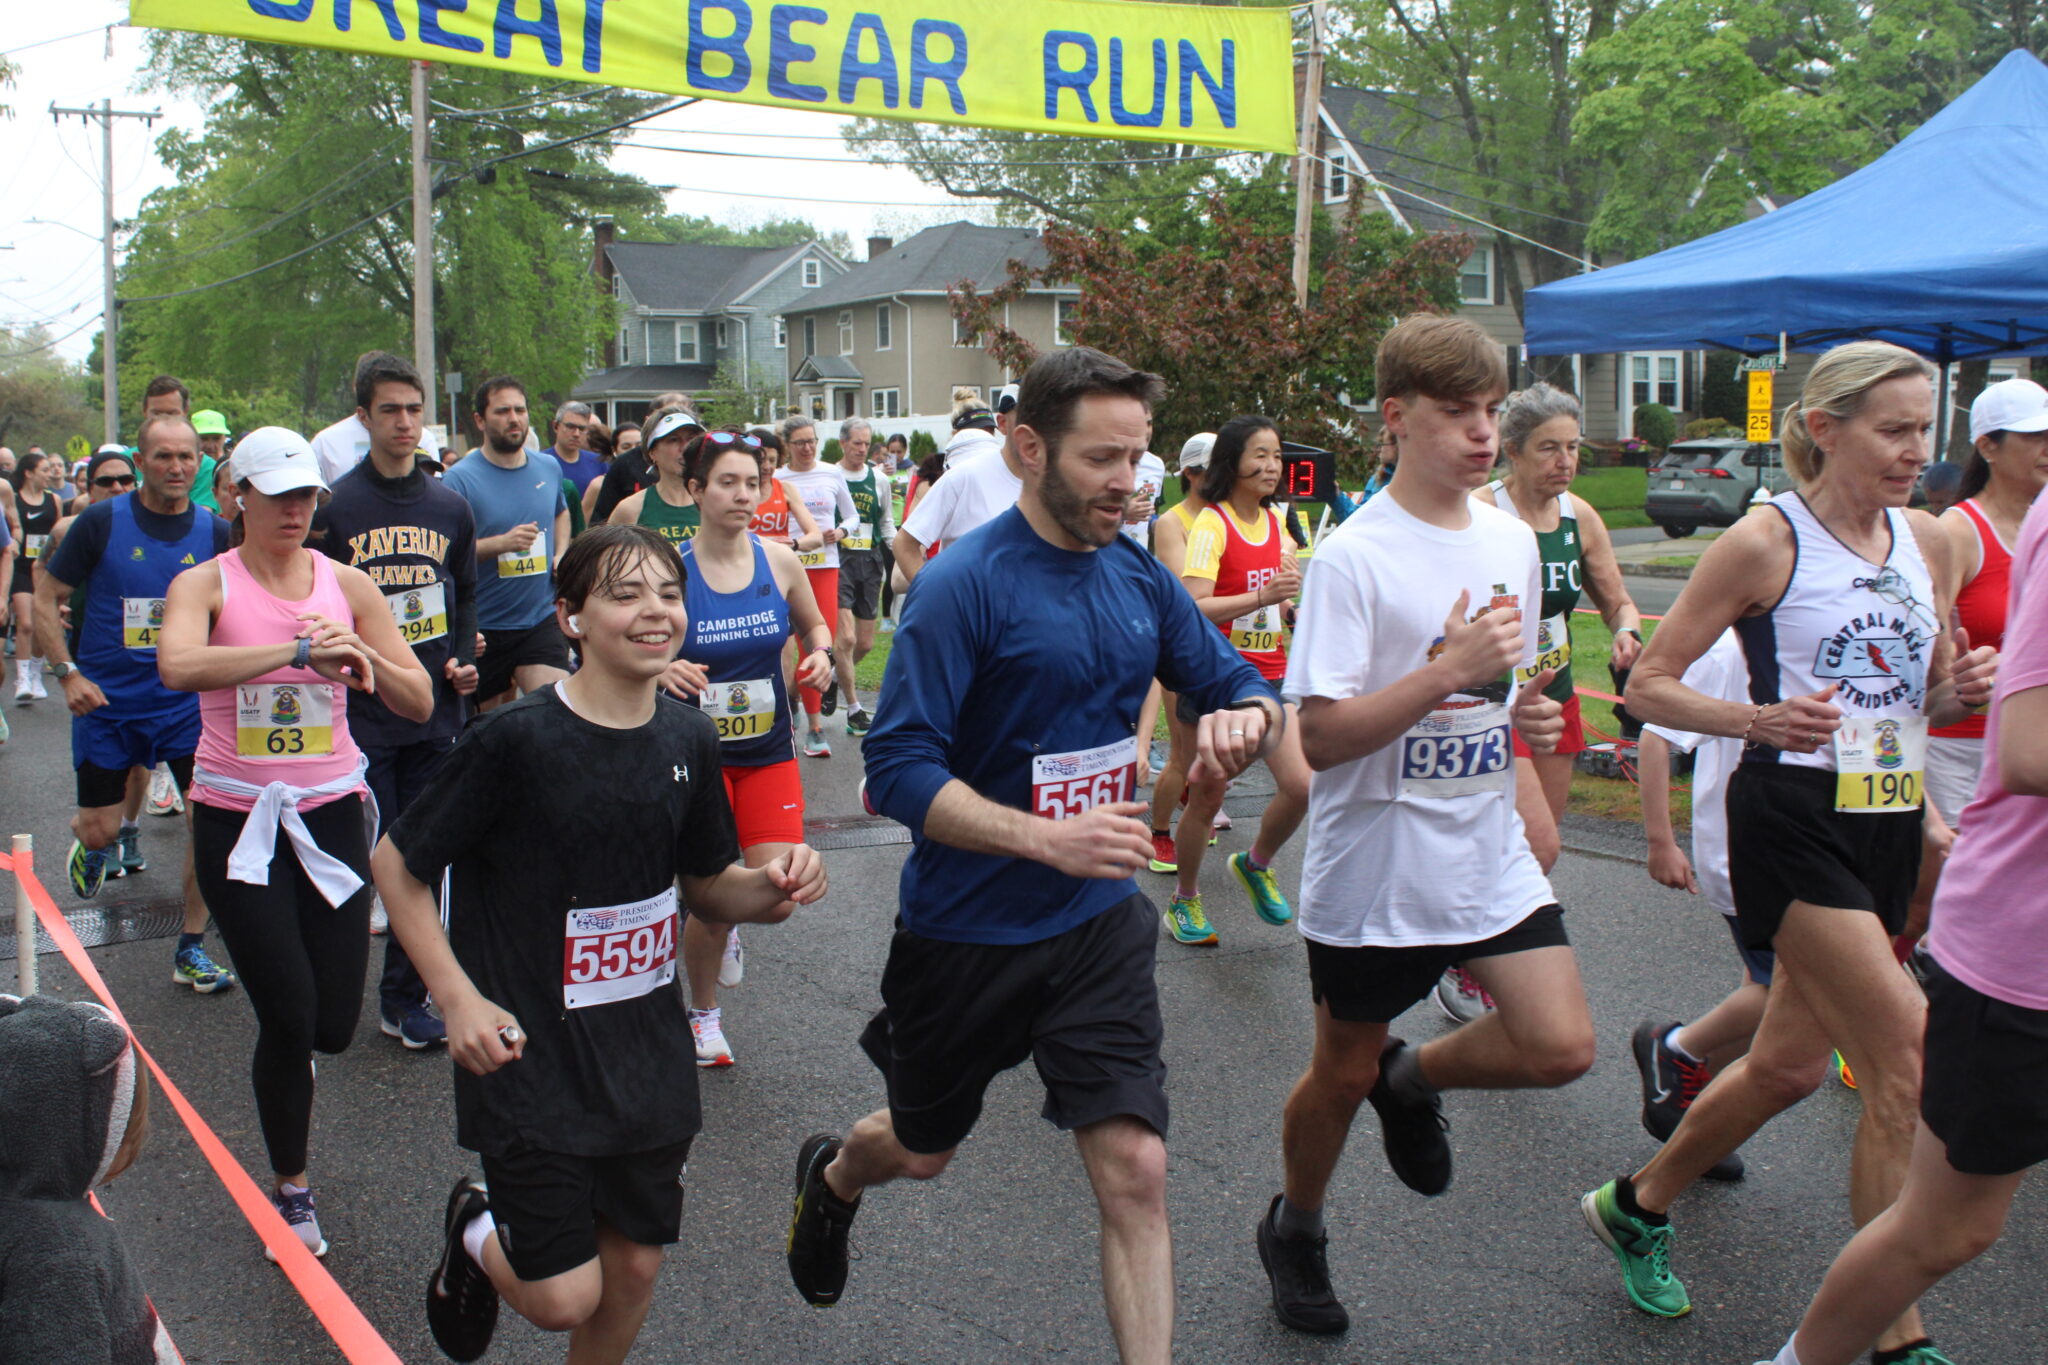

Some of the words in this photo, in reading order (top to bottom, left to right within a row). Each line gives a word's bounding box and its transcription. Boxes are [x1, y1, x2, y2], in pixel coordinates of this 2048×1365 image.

[248, 0, 602, 73] EAT
[686, 0, 967, 115] BEAR
[1043, 30, 1236, 128] RUN
[1750, 415, 1769, 430] 25
[1289, 461, 1314, 495] 13
[749, 512, 788, 531] CSU
[349, 526, 450, 566] XAVERIAN
[851, 538, 863, 548] 75
[369, 564, 437, 585] HAWKS
[515, 557, 535, 573] 44
[1540, 560, 1582, 591] FC
[697, 609, 776, 633] CAMBRIDGE
[696, 629, 750, 645] RUNNING
[753, 623, 780, 637] CLUB
[1240, 632, 1272, 649] 510
[1825, 612, 1885, 668] CENTRAL
[1889, 617, 1925, 662] MASS
[1837, 679, 1911, 710] STRIDERS
[717, 714, 757, 737] 301
[267, 728, 304, 754] 63
[1408, 728, 1509, 778] 9373
[1038, 767, 1128, 821] 5561
[1863, 773, 1914, 806] 190
[620, 894, 670, 917] PRESIDENTIAL
[620, 913, 650, 926] TIMING
[570, 917, 674, 983] 5594
